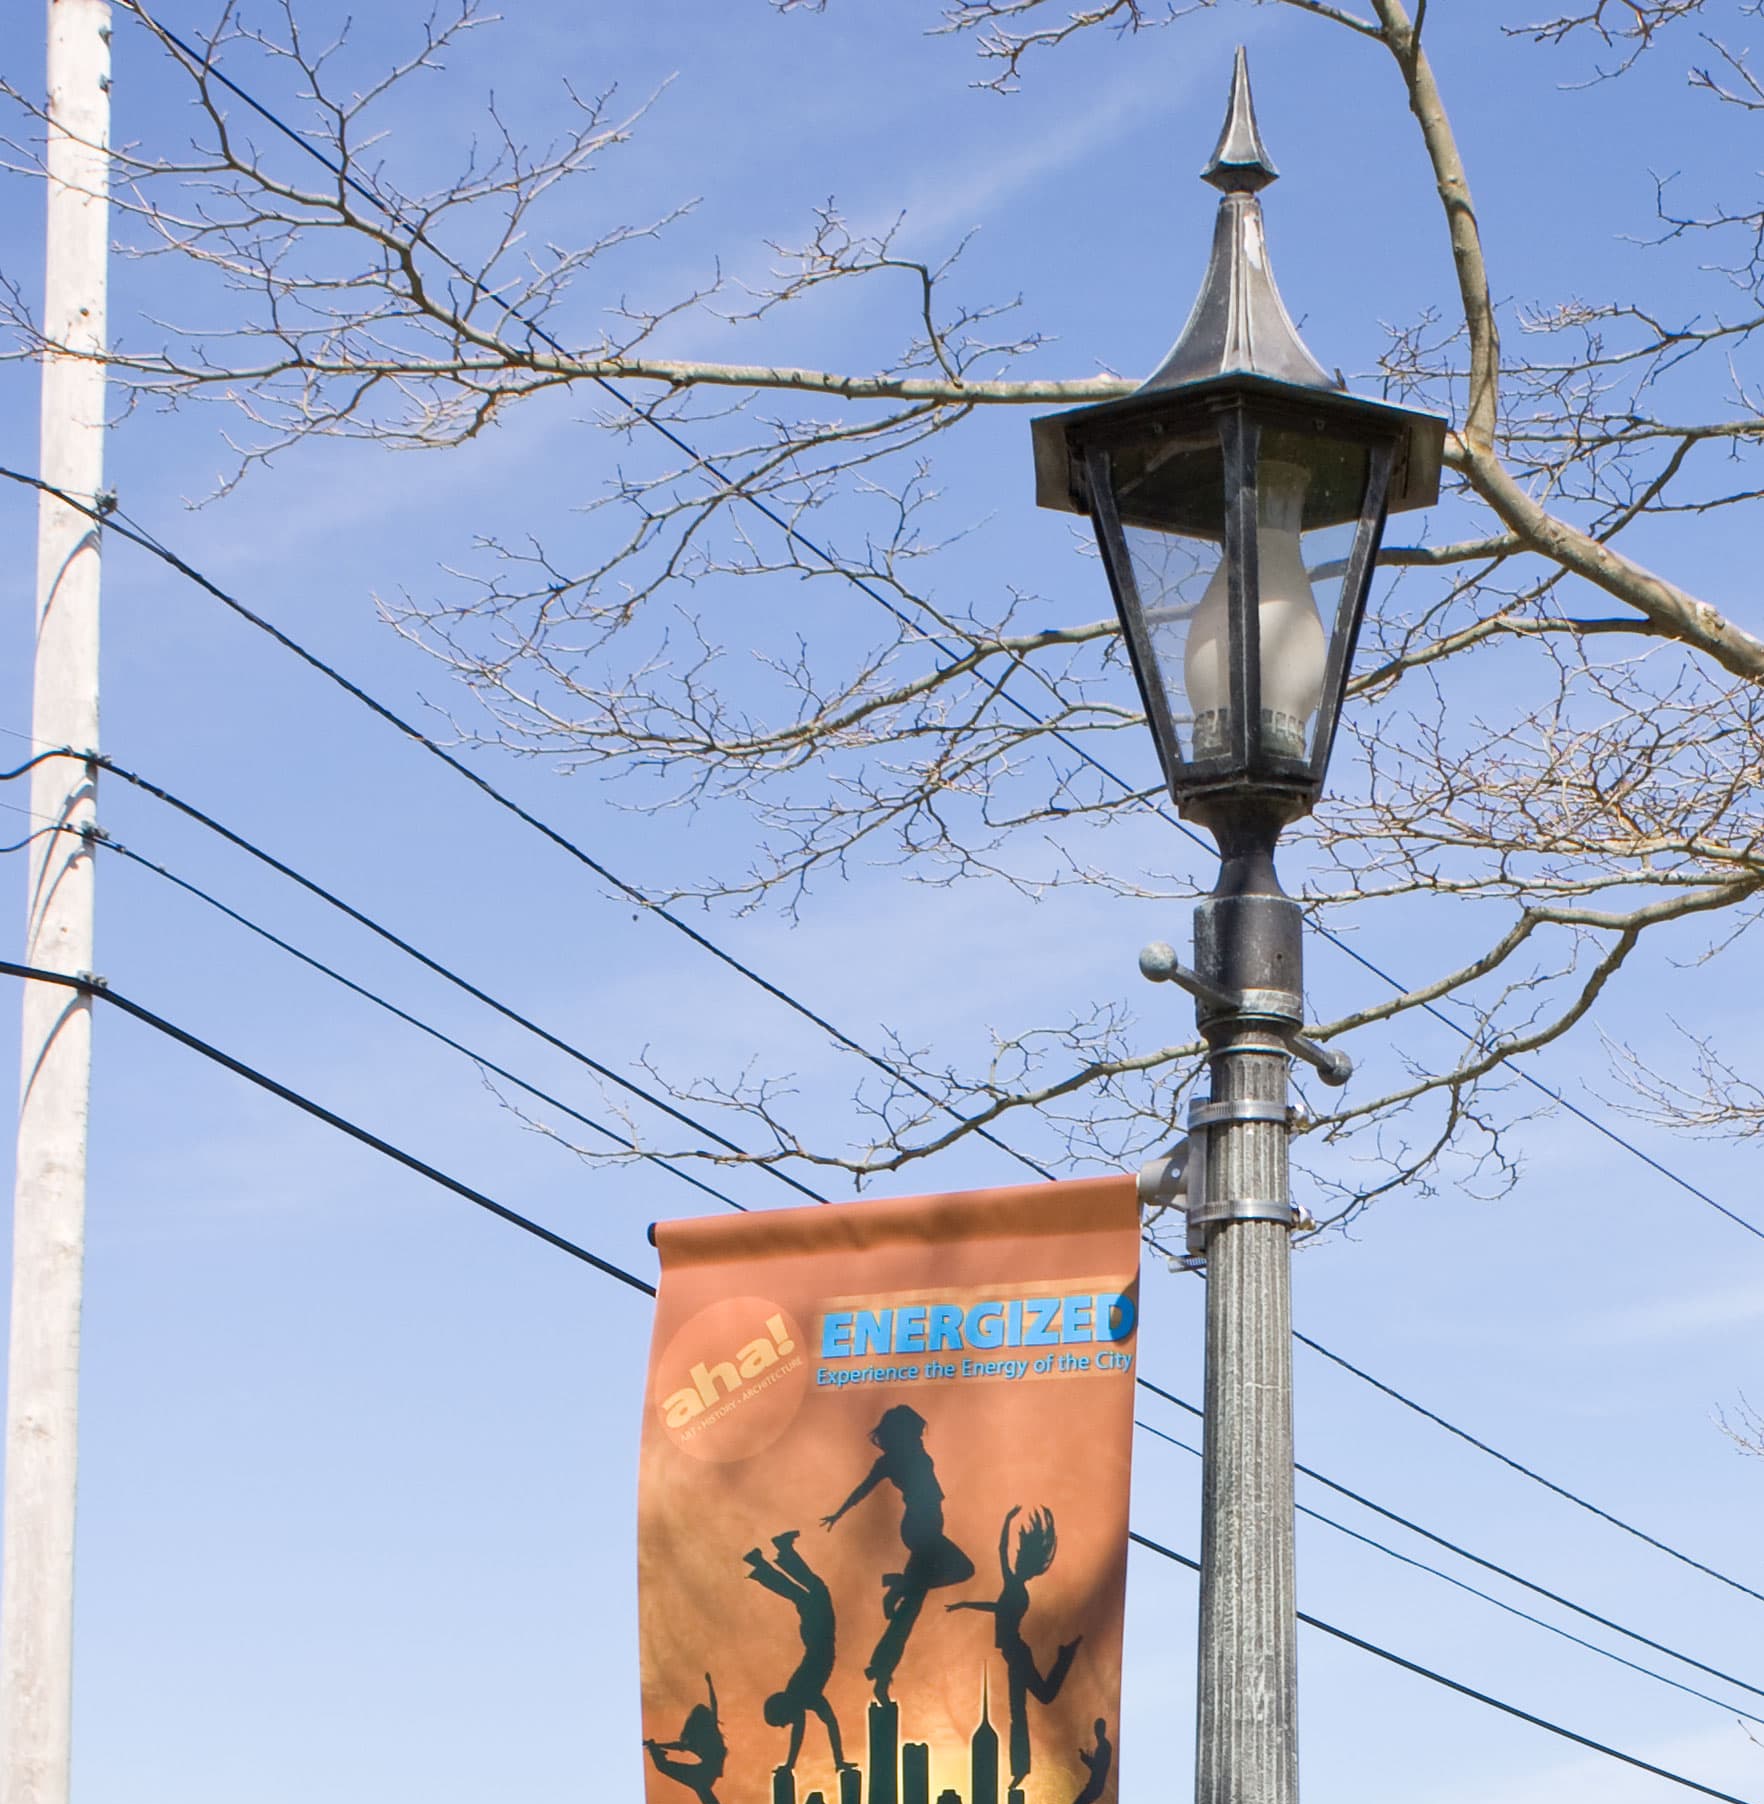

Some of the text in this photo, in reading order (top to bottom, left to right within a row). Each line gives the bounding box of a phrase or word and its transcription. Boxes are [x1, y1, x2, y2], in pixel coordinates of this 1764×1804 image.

[821, 1294, 1137, 1359] ENERGIZED
[662, 1313, 795, 1428] aha!
[742, 1356, 803, 1401] ARCHITECTURE
[816, 1350, 1134, 1387] Experience the Energy of the City
